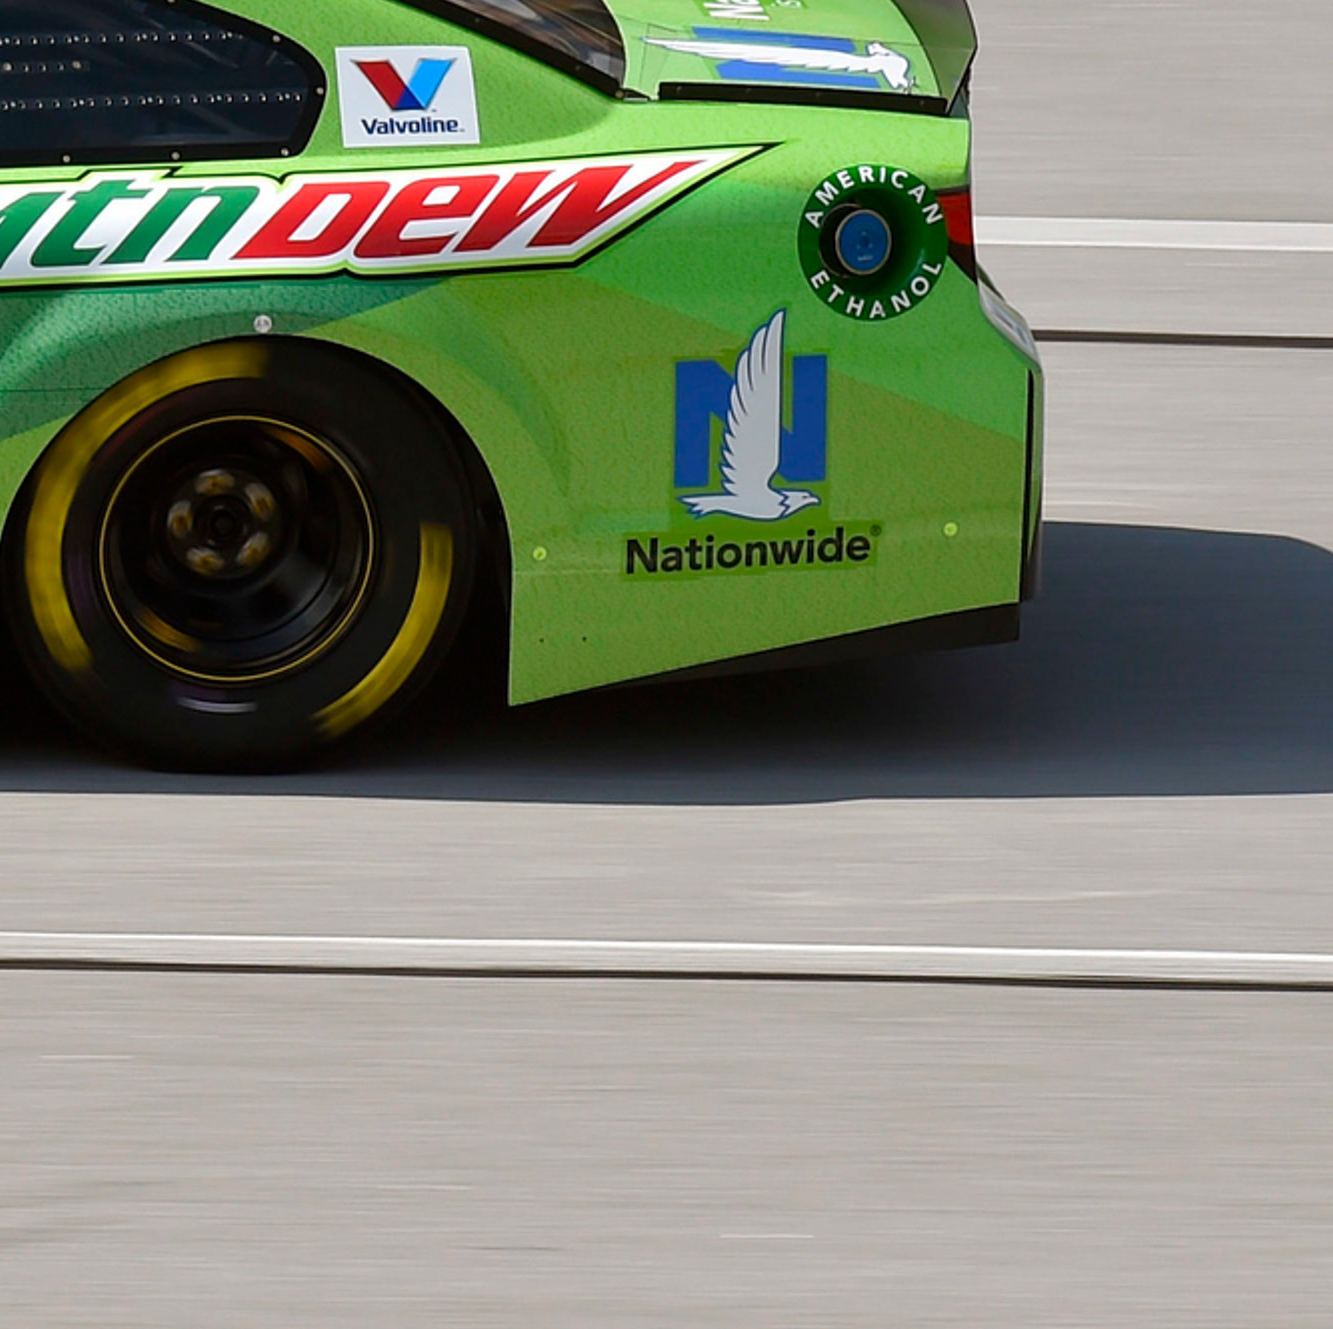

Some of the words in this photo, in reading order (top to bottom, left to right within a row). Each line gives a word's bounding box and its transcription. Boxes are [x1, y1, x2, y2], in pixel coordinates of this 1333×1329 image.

[361, 116, 459, 135] Valvoline
[805, 165, 944, 228] AMERICAN
[810, 263, 942, 319] ETHANOL
[624, 526, 872, 575] Nationwide
